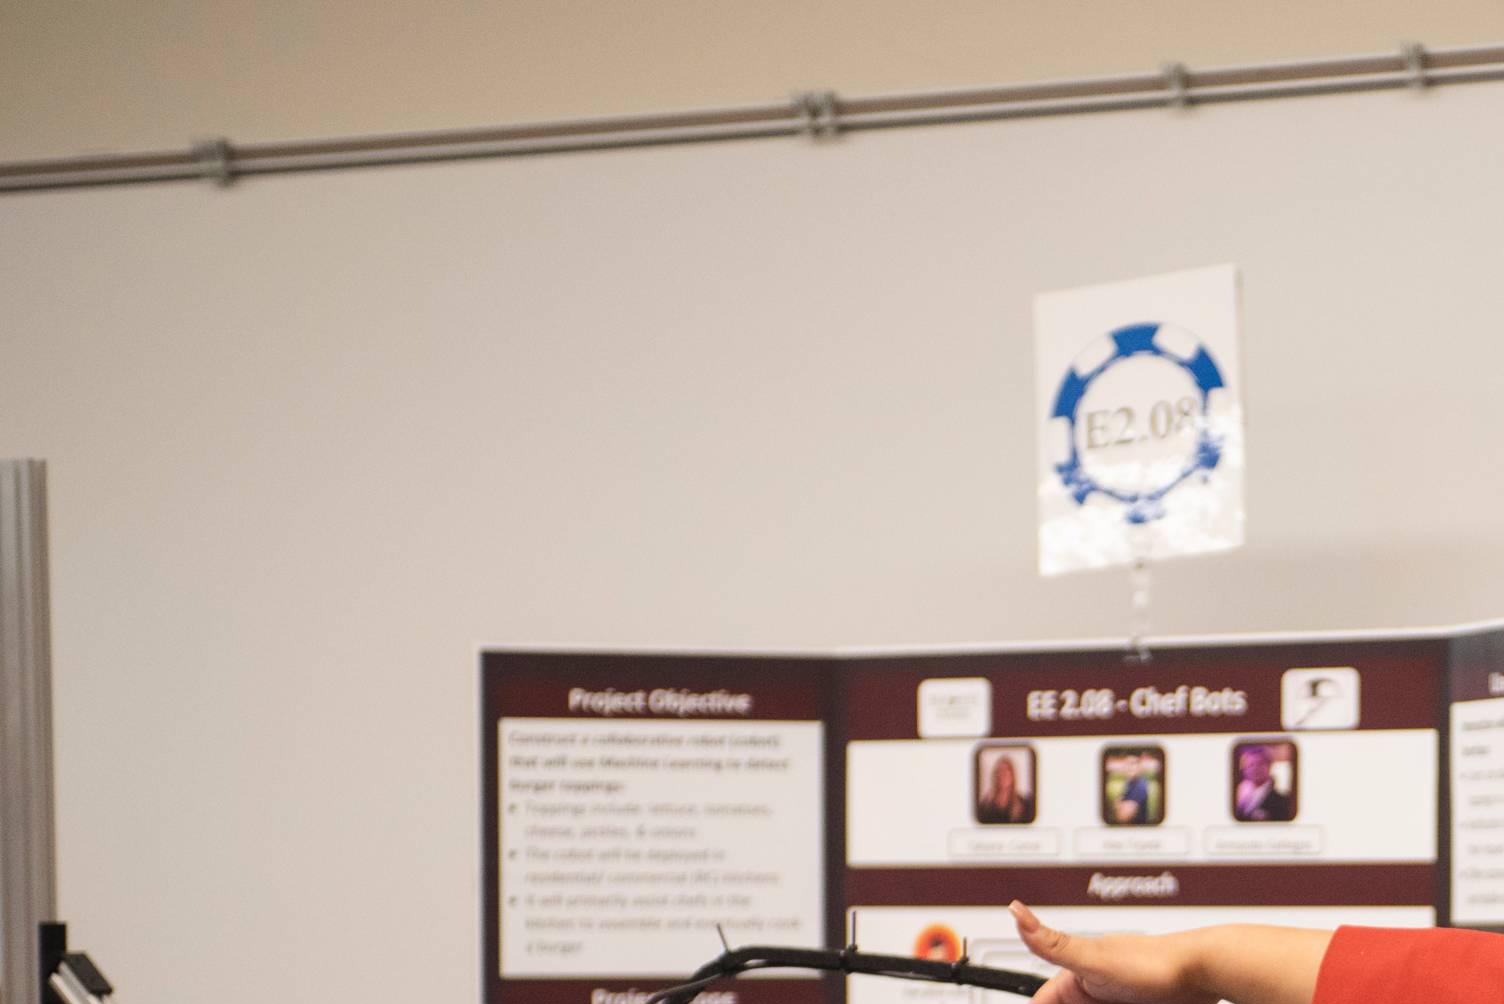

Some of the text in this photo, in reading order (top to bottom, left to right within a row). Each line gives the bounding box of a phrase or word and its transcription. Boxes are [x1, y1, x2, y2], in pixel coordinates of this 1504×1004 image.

[1085, 396, 1196, 450] E2.08
[569, 688, 751, 715] Project Objective
[1028, 690, 1057, 720] EE
[1061, 689, 1113, 719] 2.08
[1131, 687, 1186, 718] Chef
[1191, 685, 1247, 716] Bots
[1087, 872, 1178, 898] Approach
